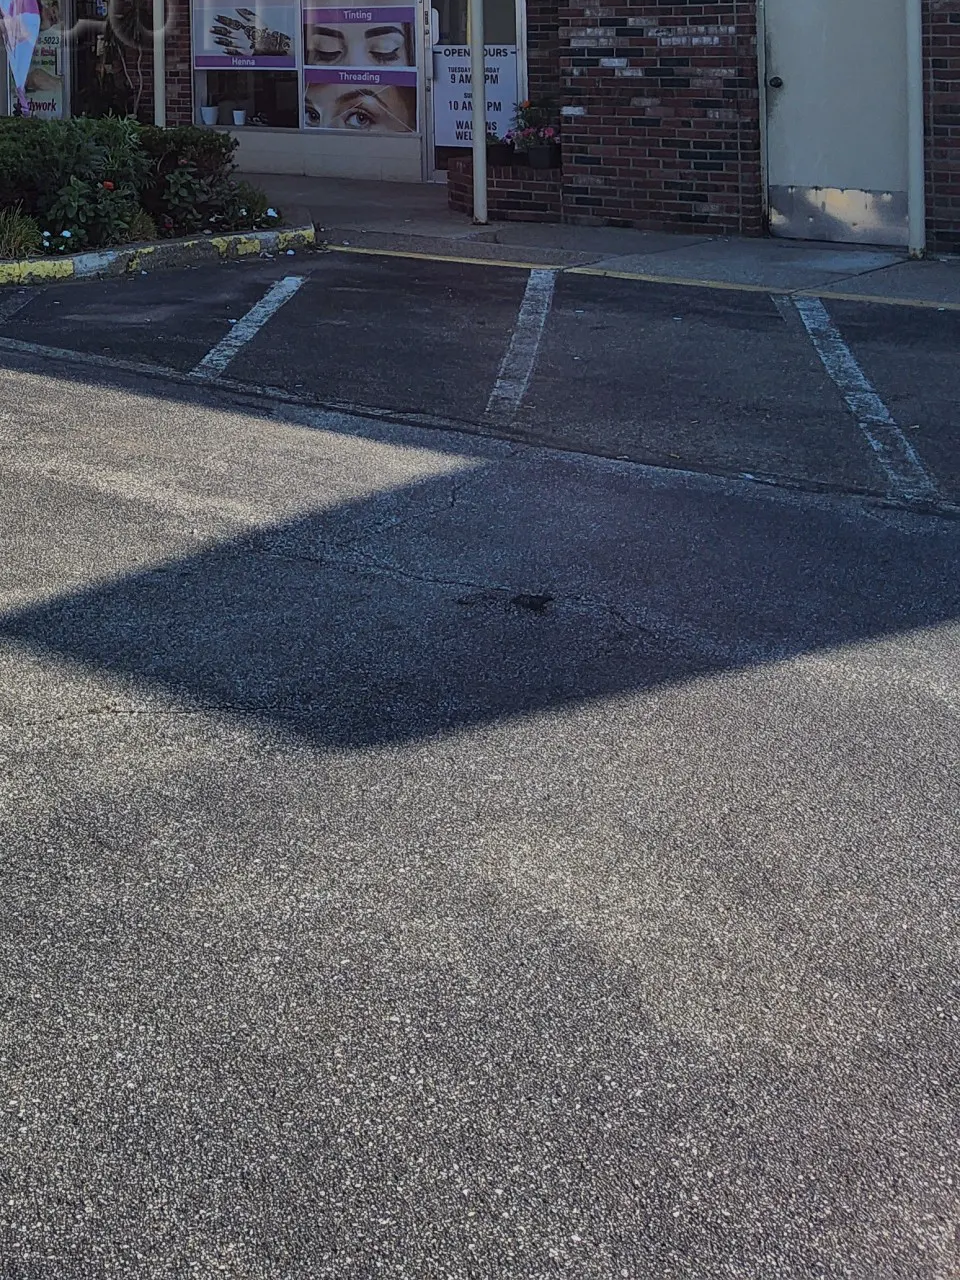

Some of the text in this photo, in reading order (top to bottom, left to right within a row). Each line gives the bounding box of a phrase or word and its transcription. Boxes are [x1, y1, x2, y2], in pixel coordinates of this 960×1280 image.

[343, 10, 372, 21] Tinting
[443, 48, 471, 57] OPEN
[231, 56, 256, 66] Henna
[338, 71, 381, 83] Threading
[450, 74, 456, 84] 9
[448, 100, 459, 111] 10
[487, 101, 502, 111] PM
